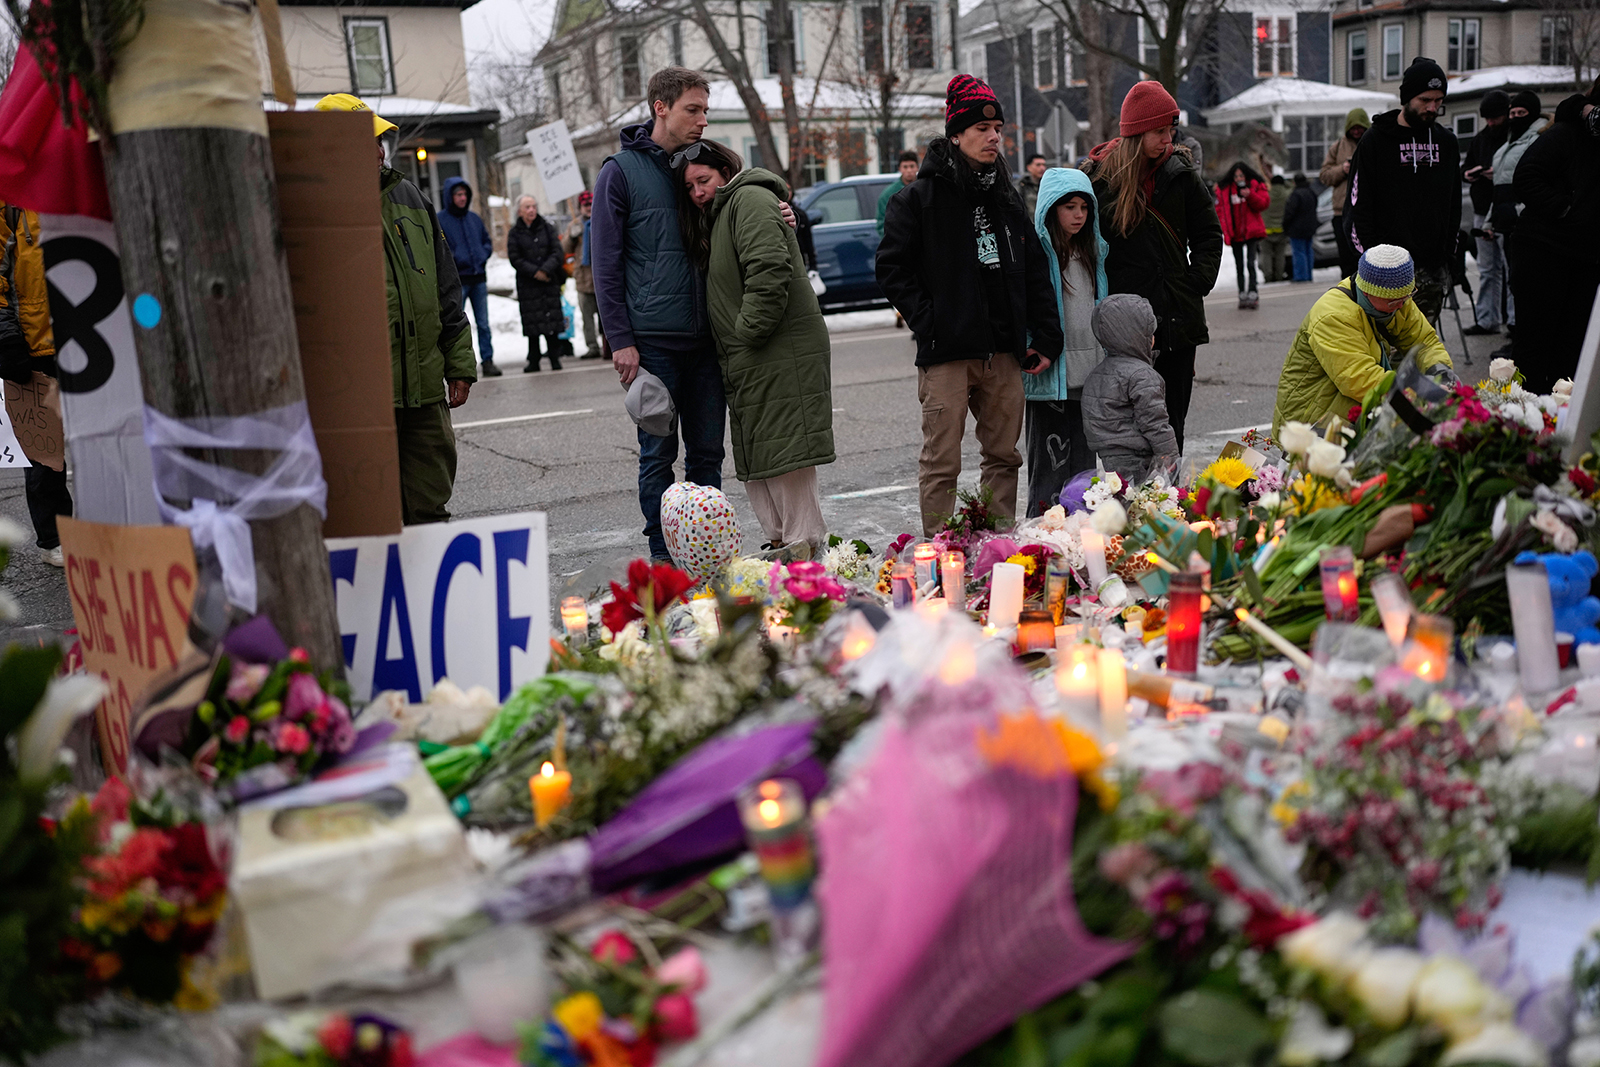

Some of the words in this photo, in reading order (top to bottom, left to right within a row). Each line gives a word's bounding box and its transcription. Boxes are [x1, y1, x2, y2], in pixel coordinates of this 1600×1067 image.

[5, 379, 48, 410] SHE
[8, 402, 48, 430] WAS
[13, 425, 57, 454] OOD
[67, 553, 117, 655] SHE
